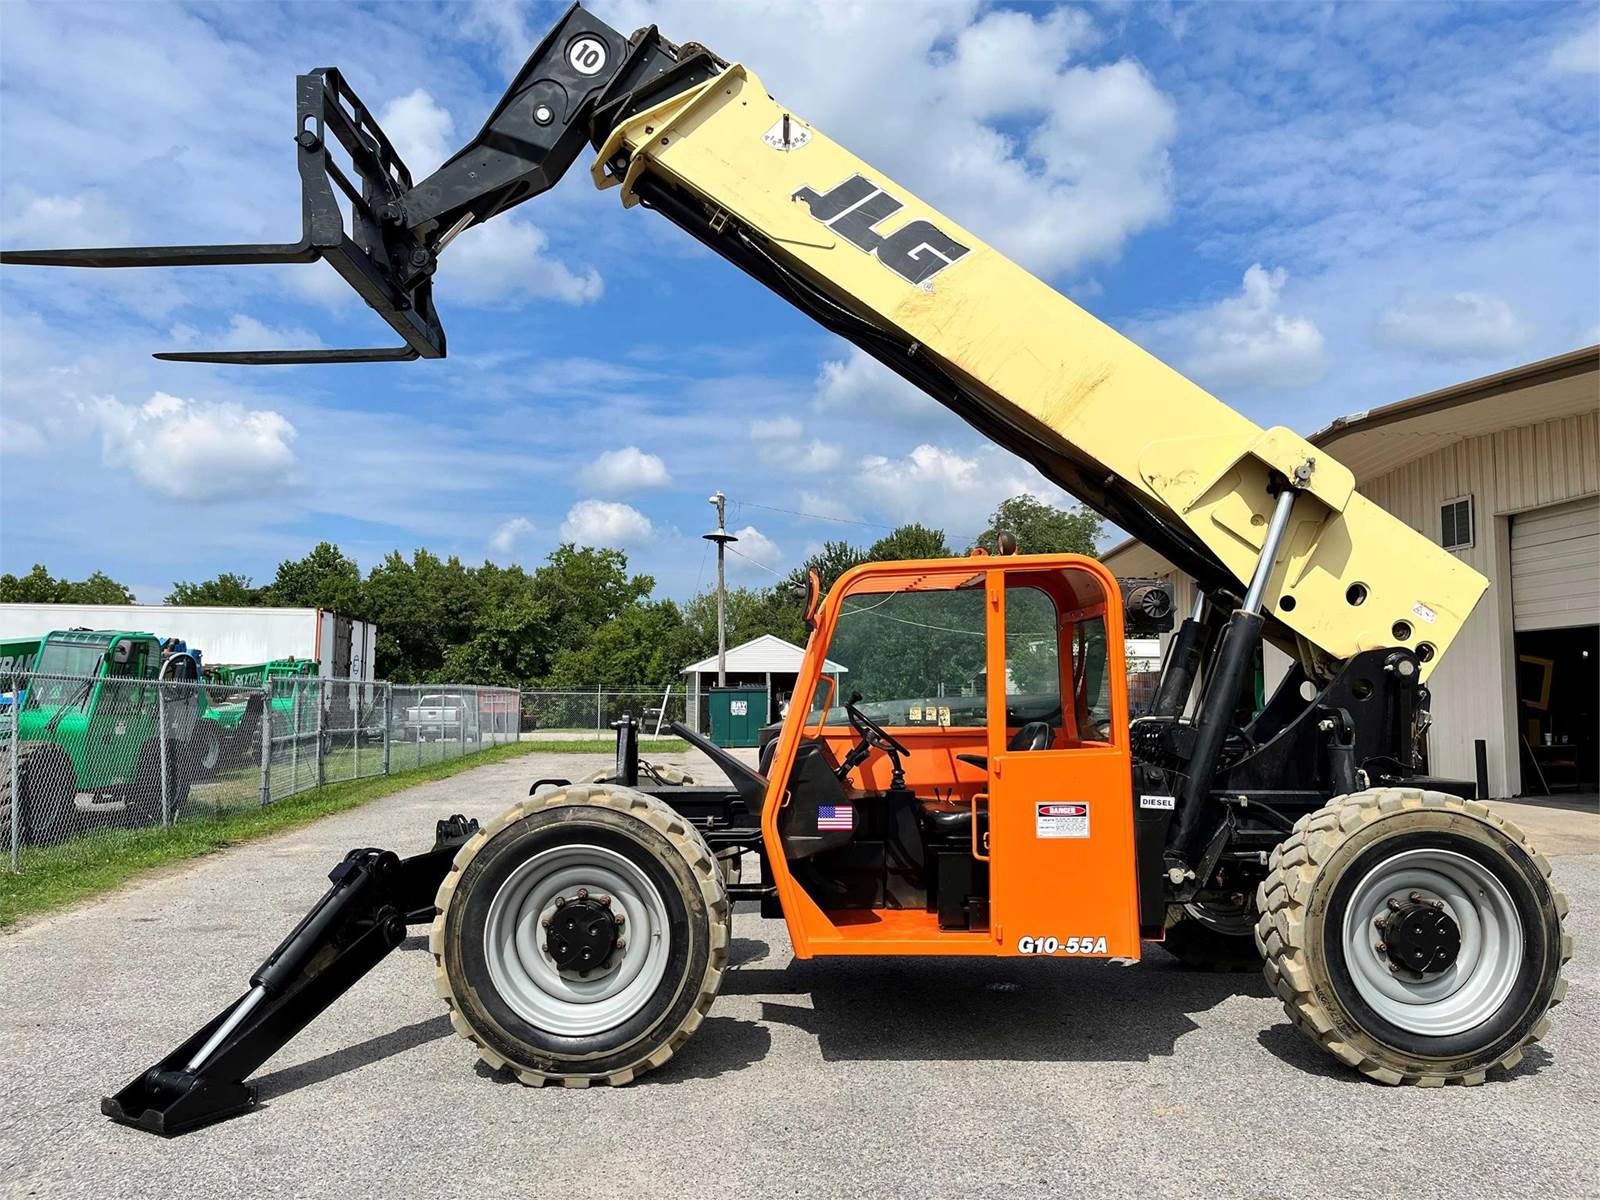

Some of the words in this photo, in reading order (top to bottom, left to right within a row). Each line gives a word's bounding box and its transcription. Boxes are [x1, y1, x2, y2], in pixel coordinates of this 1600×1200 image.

[575, 43, 600, 68] 10
[791, 174, 971, 285] JLG
[0, 654, 38, 673] RAK
[235, 672, 263, 687] SKYTRA
[1142, 798, 1173, 807] DIESEL
[1018, 936, 1108, 953] G10-55A
